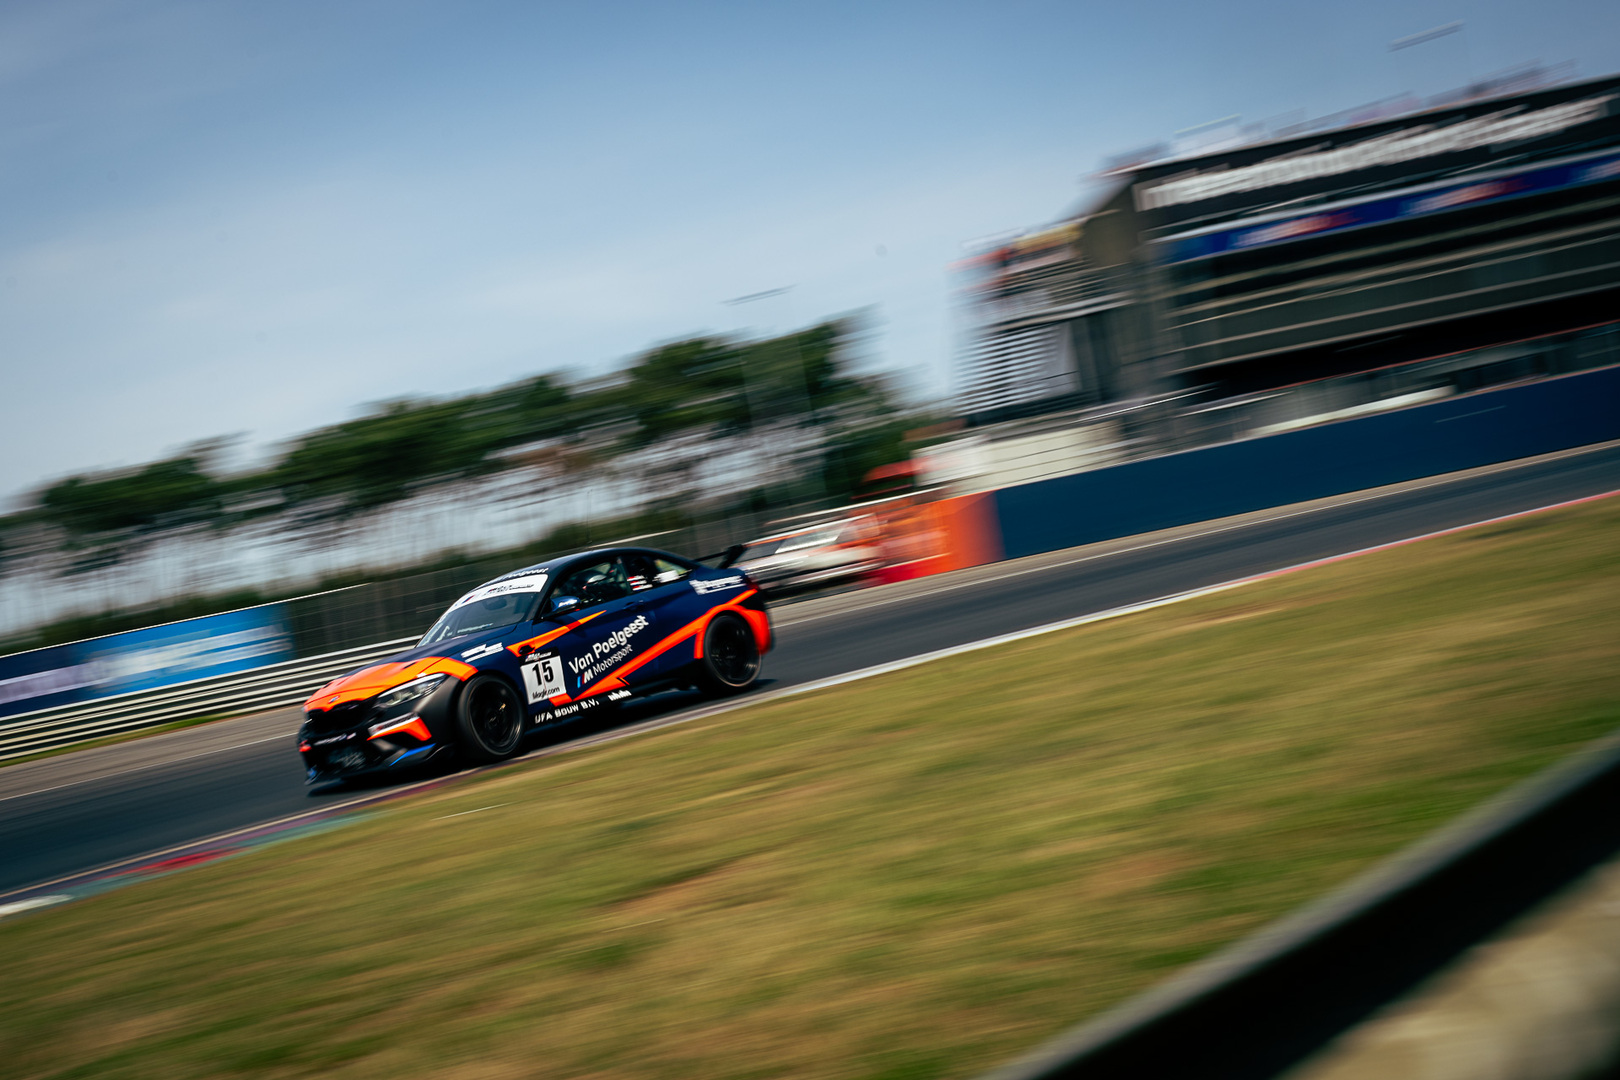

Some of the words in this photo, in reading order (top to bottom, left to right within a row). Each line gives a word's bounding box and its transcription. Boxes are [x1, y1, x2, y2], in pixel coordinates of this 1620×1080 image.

[568, 652, 594, 674] Van
[592, 614, 649, 659] Poelgeest
[532, 660, 554, 686] 15
[592, 643, 633, 676] Motorsport
[534, 711, 553, 724] UFA
